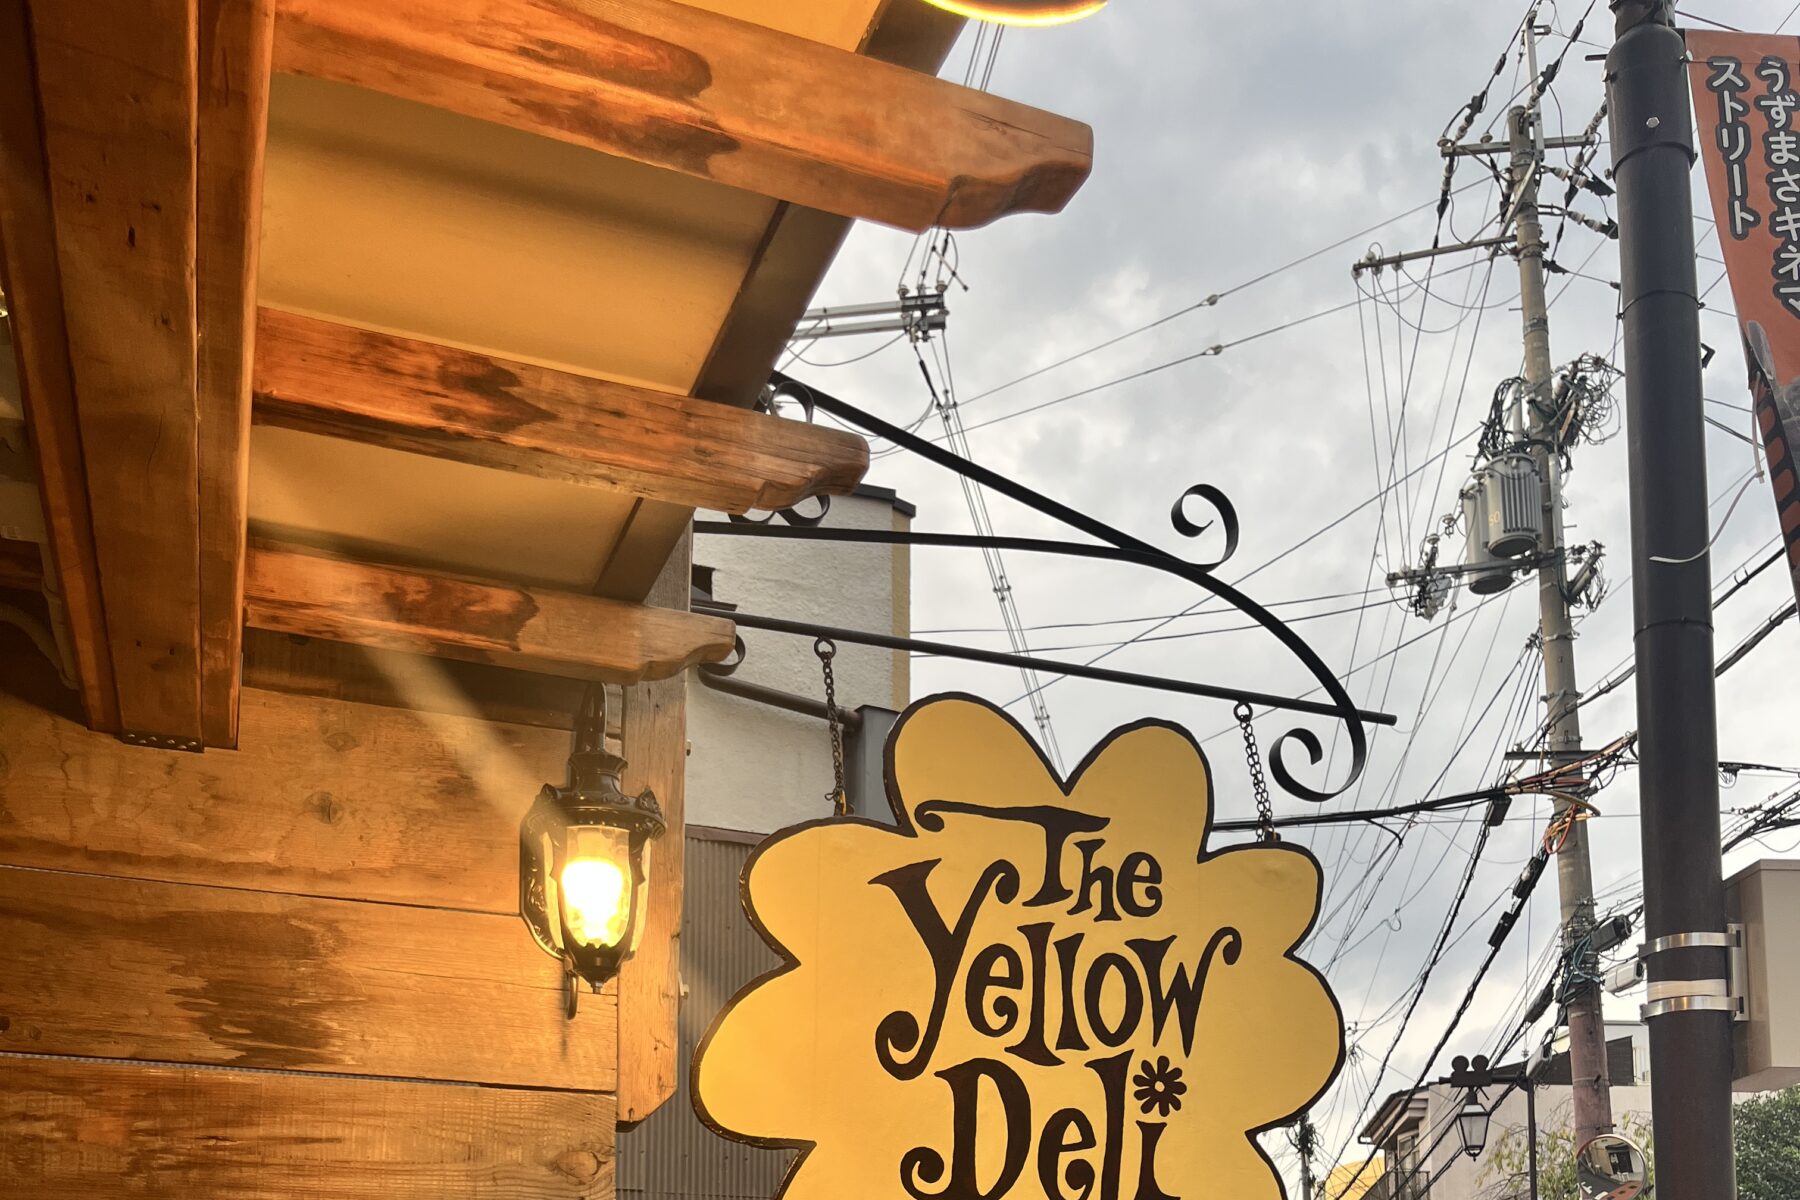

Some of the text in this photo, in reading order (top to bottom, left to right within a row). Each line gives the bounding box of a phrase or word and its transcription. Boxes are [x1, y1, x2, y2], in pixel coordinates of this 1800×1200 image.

[1712, 61, 1755, 235] ストリート
[915, 800, 1162, 922] The
[868, 858, 1242, 1081] Yellow
